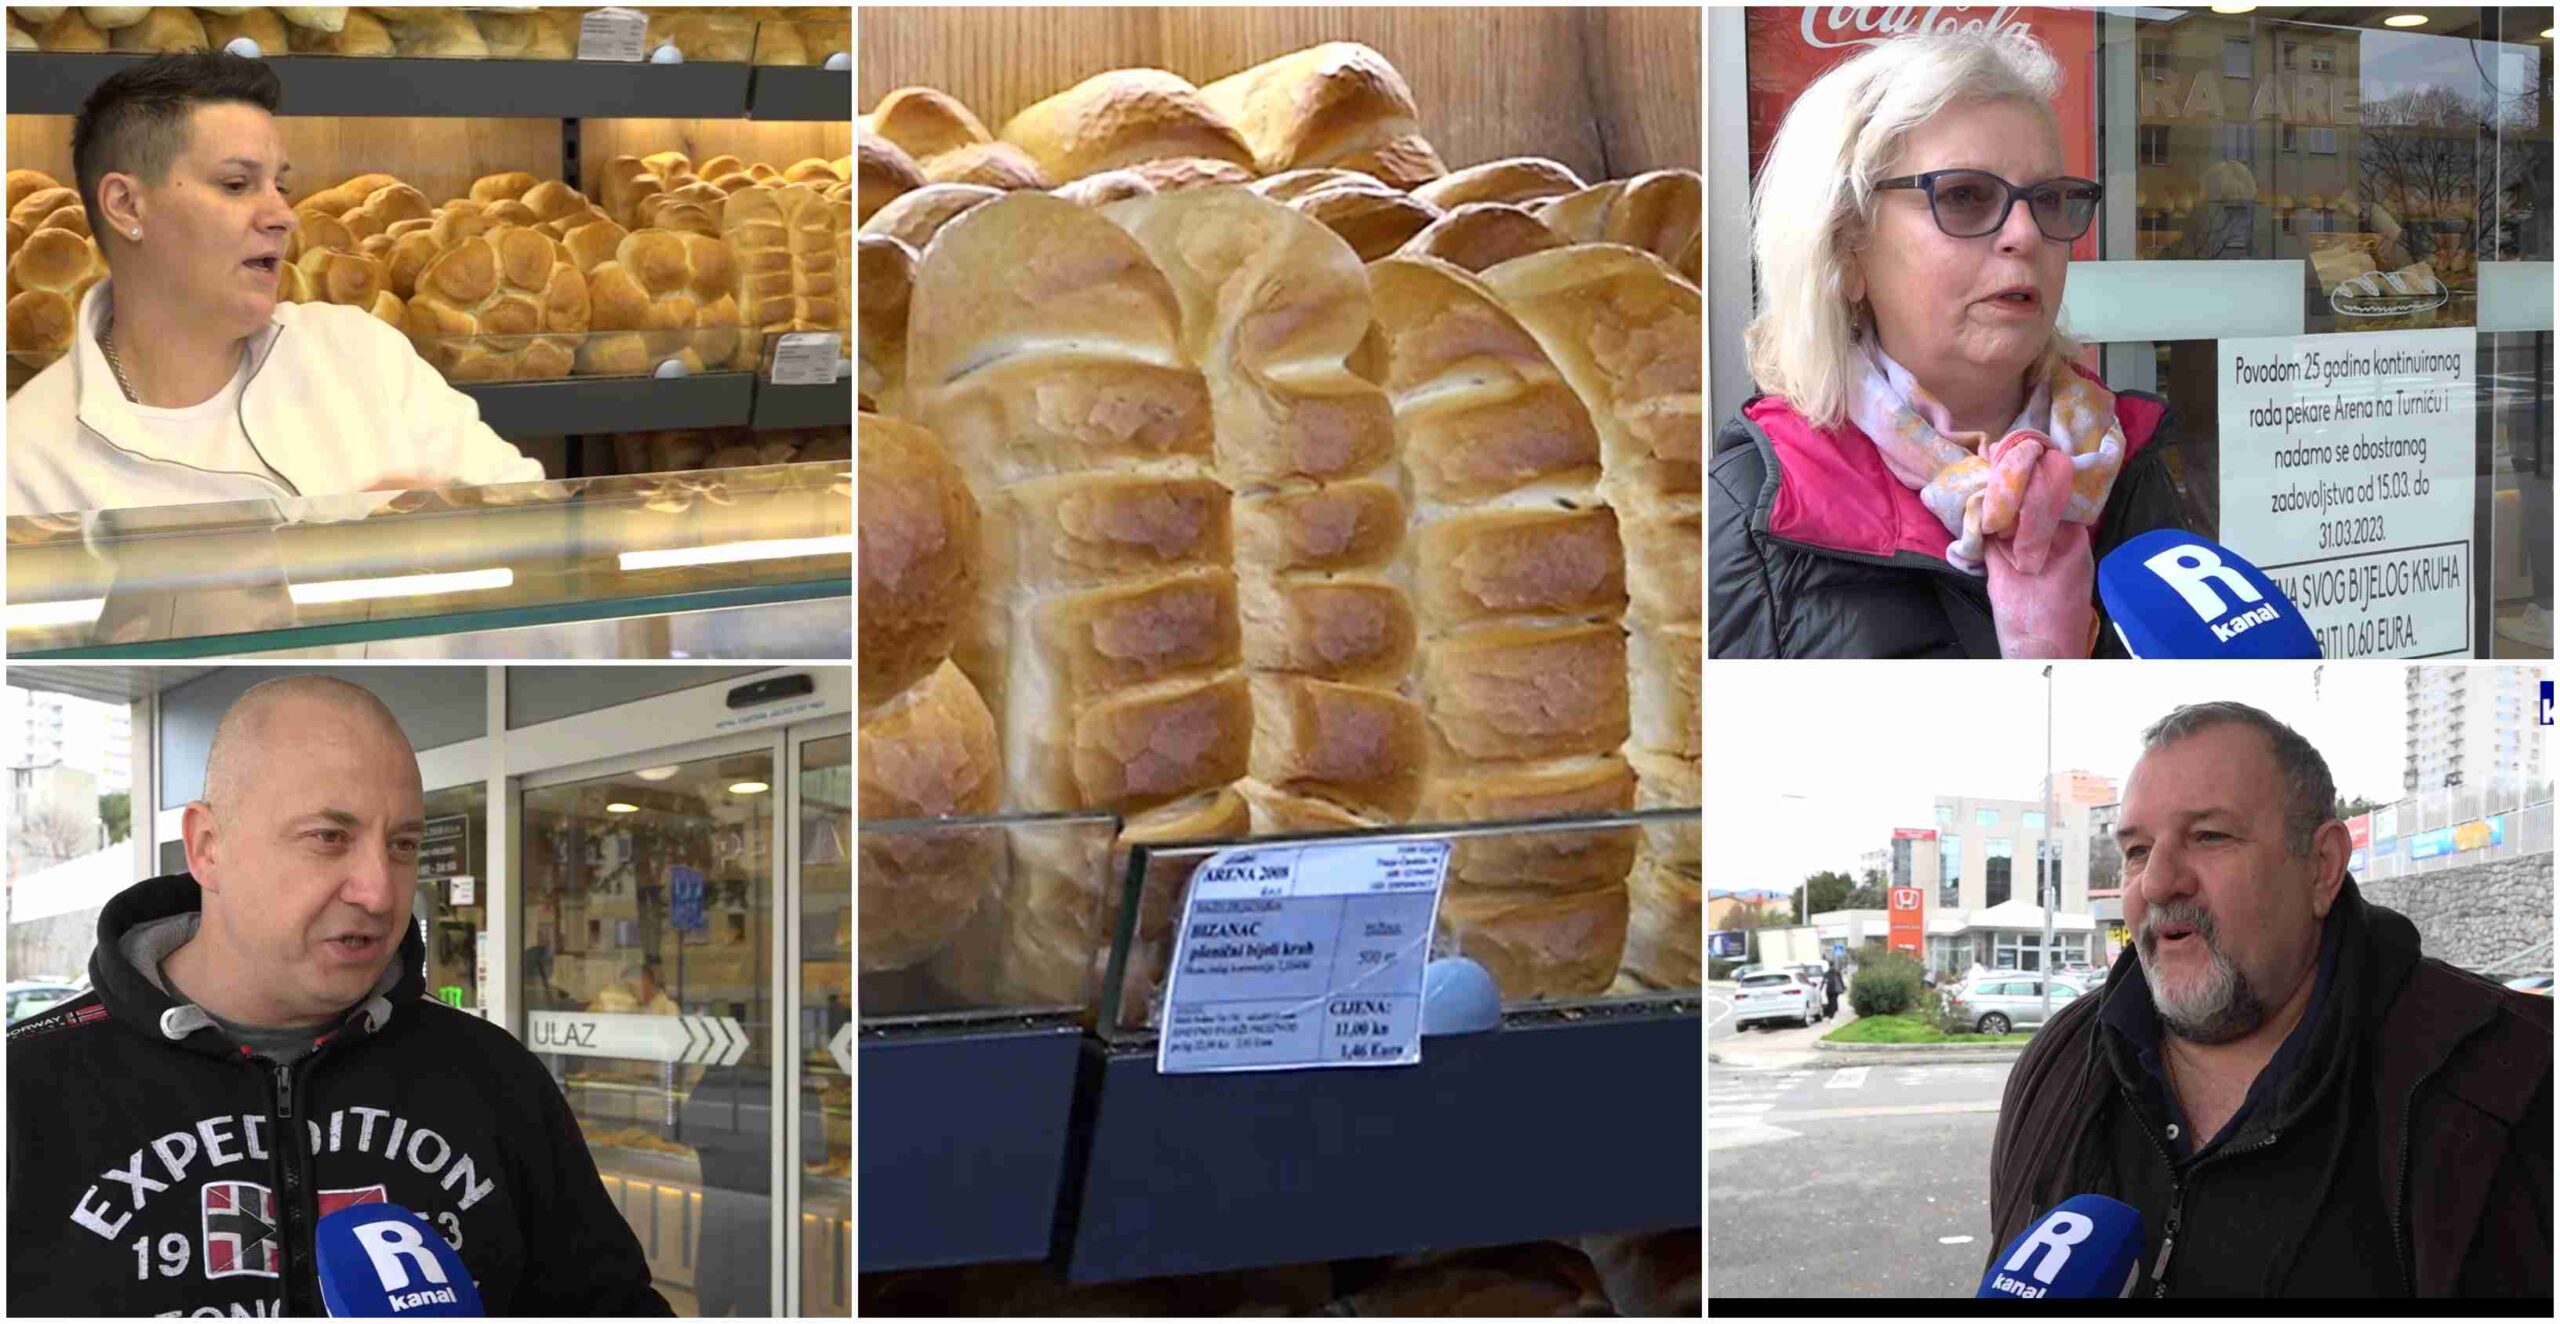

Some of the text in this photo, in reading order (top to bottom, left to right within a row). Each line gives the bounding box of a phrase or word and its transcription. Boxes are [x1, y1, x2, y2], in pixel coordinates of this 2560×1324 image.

[2236, 348, 2460, 388] Povodom 25 godina kontinuiranog
[2250, 389, 2449, 434] rada pekare Arena na Turniću i
[2275, 434, 2427, 469] nadamo se obostranog
[2271, 470, 2430, 515] zadovoljstva od 15.03. do
[2319, 515, 2386, 549] 31.03.2023.
[2143, 544, 2264, 624] R
[2302, 568, 2345, 609] SVOG
[2349, 560, 2409, 612] BIJELOG
[2412, 554, 2461, 593] KRUHA
[2210, 603, 2280, 644] kanal
[2348, 619, 2374, 659] 0.60
[2378, 613, 2418, 653] EURA.
[6, 1016, 61, 1038] ORWAY
[534, 1020, 597, 1049] ULAZ
[131, 1232, 191, 1281] 19
[352, 1220, 449, 1293] R
[2003, 1211, 2094, 1285] R
[388, 1286, 457, 1313] kanal
